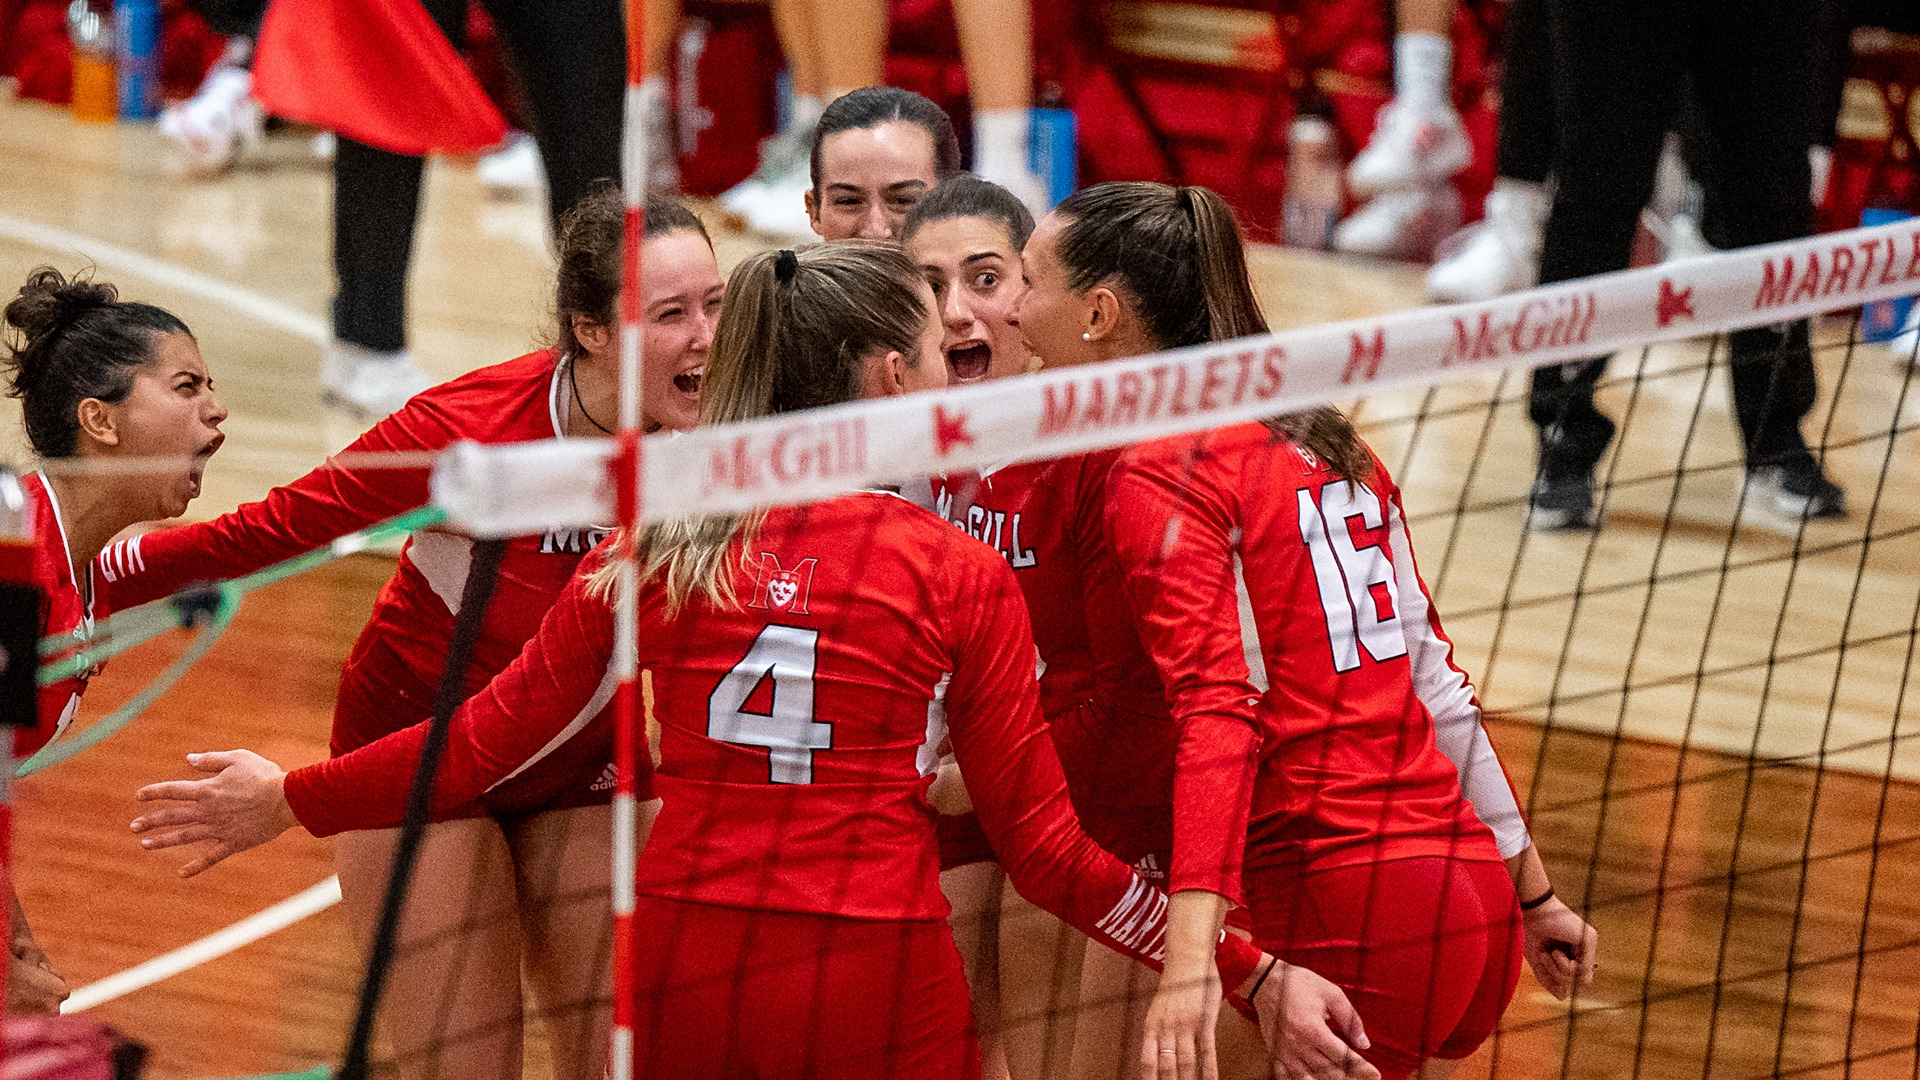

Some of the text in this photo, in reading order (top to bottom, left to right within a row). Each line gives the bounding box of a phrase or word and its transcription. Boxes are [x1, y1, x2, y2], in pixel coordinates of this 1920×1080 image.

[1037, 344, 1286, 438] MARTLETS
[1440, 291, 1596, 367] McGill
[1296, 478, 1408, 675] 16
[708, 623, 834, 785] 4
